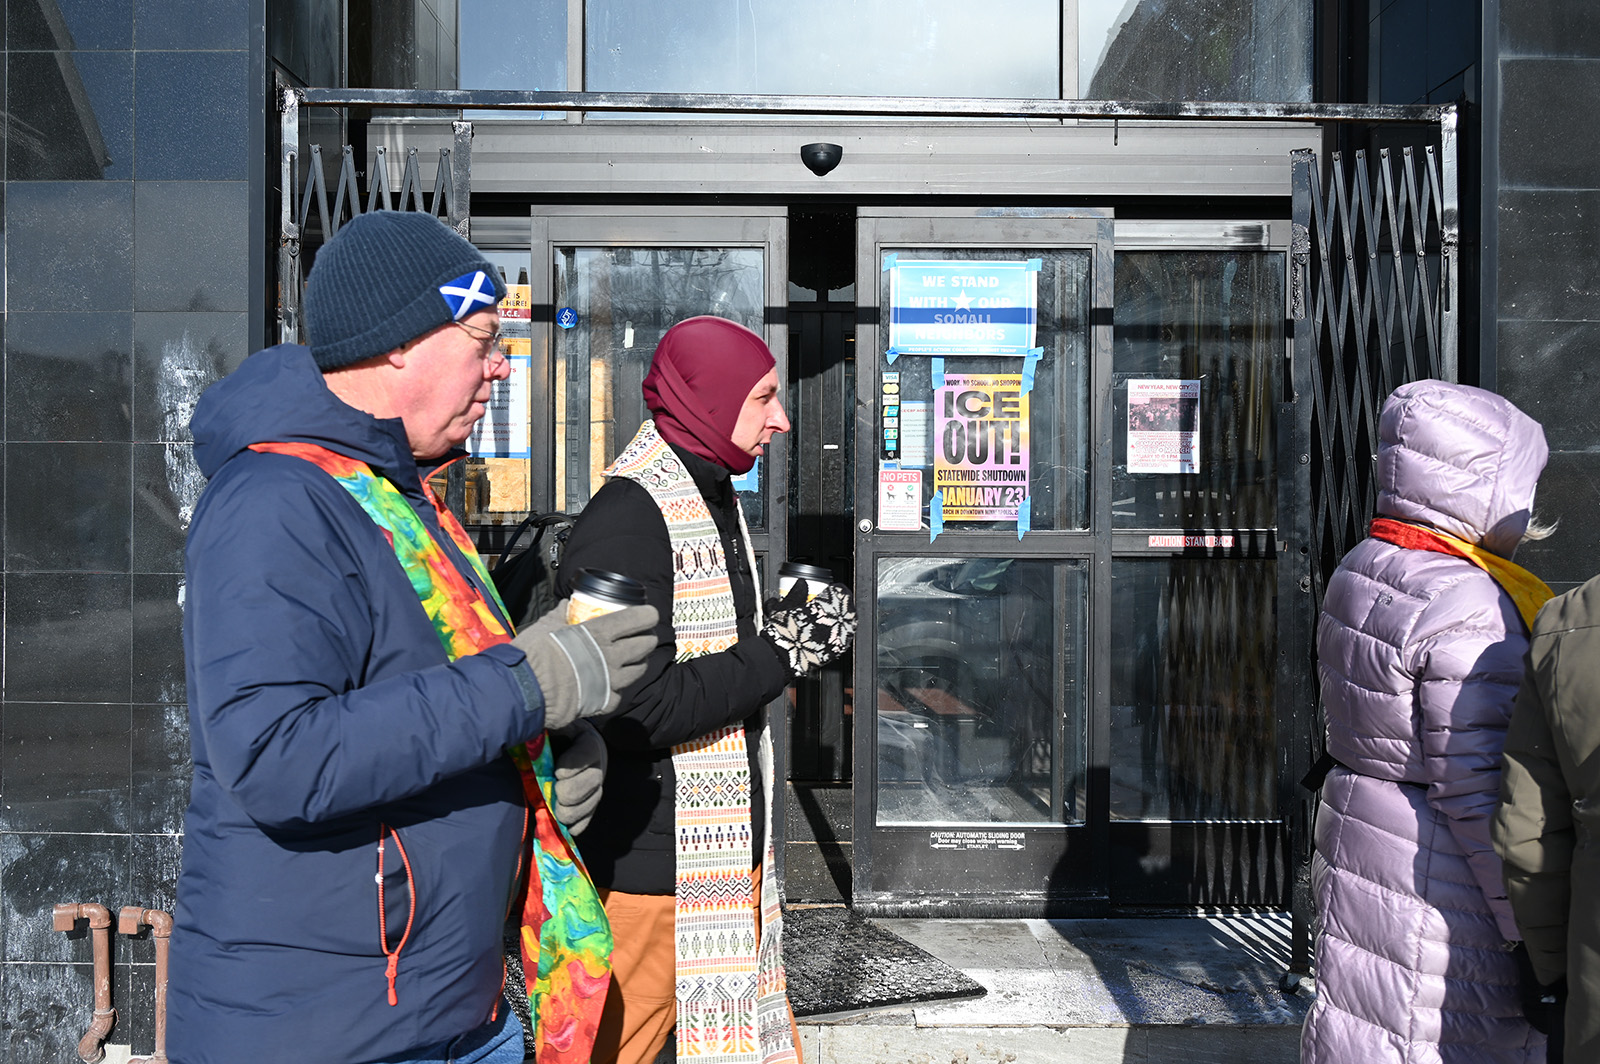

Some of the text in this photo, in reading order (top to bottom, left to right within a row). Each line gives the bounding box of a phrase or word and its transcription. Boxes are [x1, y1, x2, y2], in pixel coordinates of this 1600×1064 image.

[922, 275, 999, 288] WE STAND
[908, 296, 1011, 308] WITH OUR
[934, 314, 991, 325] SOMALI
[915, 328, 1006, 342] NEIGHBORS
[1000, 379, 1021, 387] SHOPPIN
[944, 390, 1020, 418] ICE
[943, 420, 1021, 465] OUT!
[883, 472, 918, 482] NO PETS
[937, 469, 1026, 481] STATEWIDE SHUTDOWN
[942, 487, 1024, 506] JANUARY 23
[1150, 536, 1233, 547] CAUTION STAND BACK
